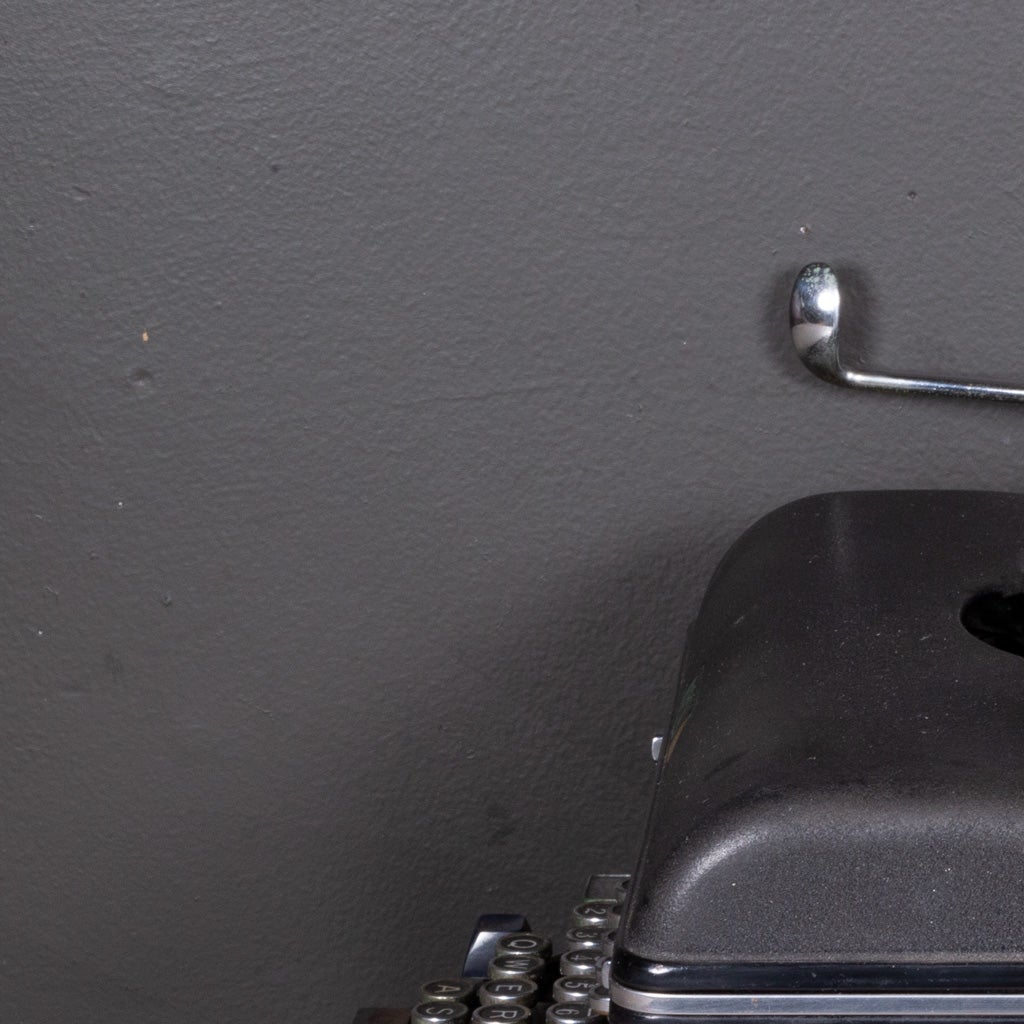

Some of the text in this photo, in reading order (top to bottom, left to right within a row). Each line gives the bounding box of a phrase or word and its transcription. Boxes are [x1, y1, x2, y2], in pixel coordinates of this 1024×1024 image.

[506, 939, 537, 949] Q
[503, 959, 529, 970] W
[433, 984, 461, 993] A
[494, 983, 523, 992] E
[425, 1006, 455, 1015] S
[489, 1010, 518, 1019] R
